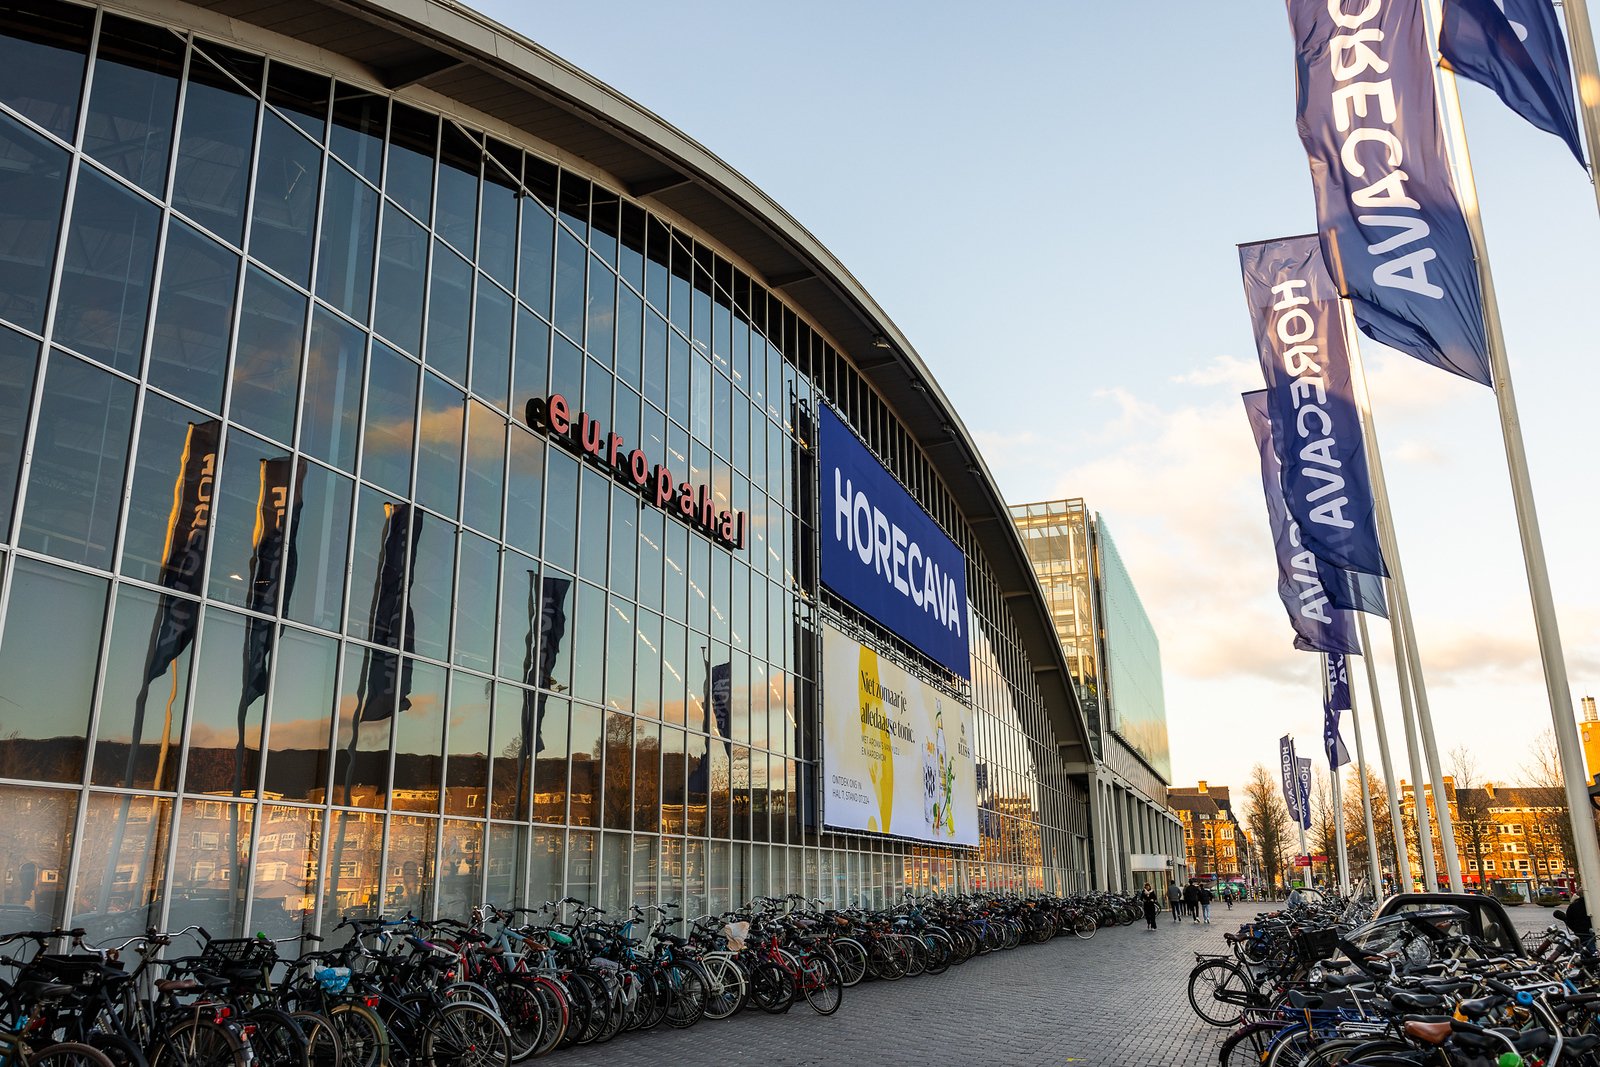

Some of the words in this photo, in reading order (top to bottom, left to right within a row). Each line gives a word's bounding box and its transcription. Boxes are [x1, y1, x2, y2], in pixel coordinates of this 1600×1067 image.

[547, 393, 745, 550] europahal
[835, 467, 961, 638] HORECAVA
[861, 670, 875, 697] Niet
[875, 682, 900, 708] zomaar
[900, 690, 907, 715] je
[861, 702, 897, 739] alledaagse
[897, 720, 916, 744] tonic.
